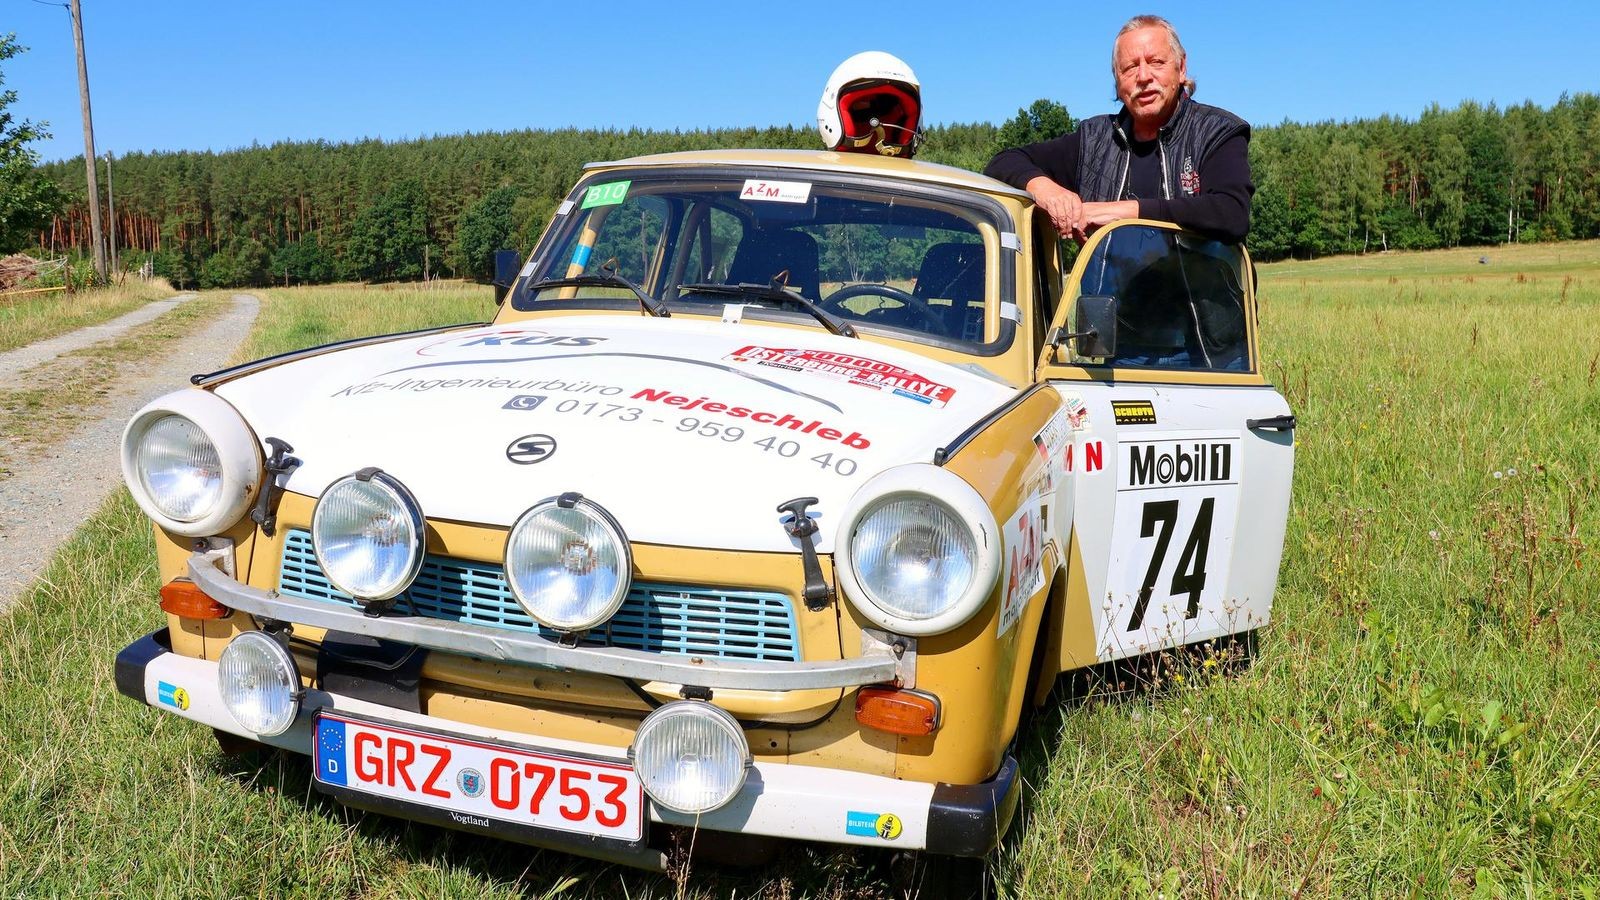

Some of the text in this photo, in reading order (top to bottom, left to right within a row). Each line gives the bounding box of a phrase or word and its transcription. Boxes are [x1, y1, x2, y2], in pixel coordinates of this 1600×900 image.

[588, 183, 627, 202] B10
[330, 376, 623, 398] Kfz-Ingenieurbüro
[630, 388, 871, 450] Nejeschleb
[555, 399, 643, 422] 0173
[676, 417, 745, 443] 959
[753, 436, 800, 459] 40
[810, 452, 858, 477] 40
[1085, 441, 1103, 472] N
[1129, 443, 1206, 486] Mobil
[1126, 497, 1215, 632] 74
[328, 758, 338, 774] D
[354, 731, 451, 799] GRZ
[490, 757, 628, 828] 0753
[450, 812, 489, 828] Vogtland
